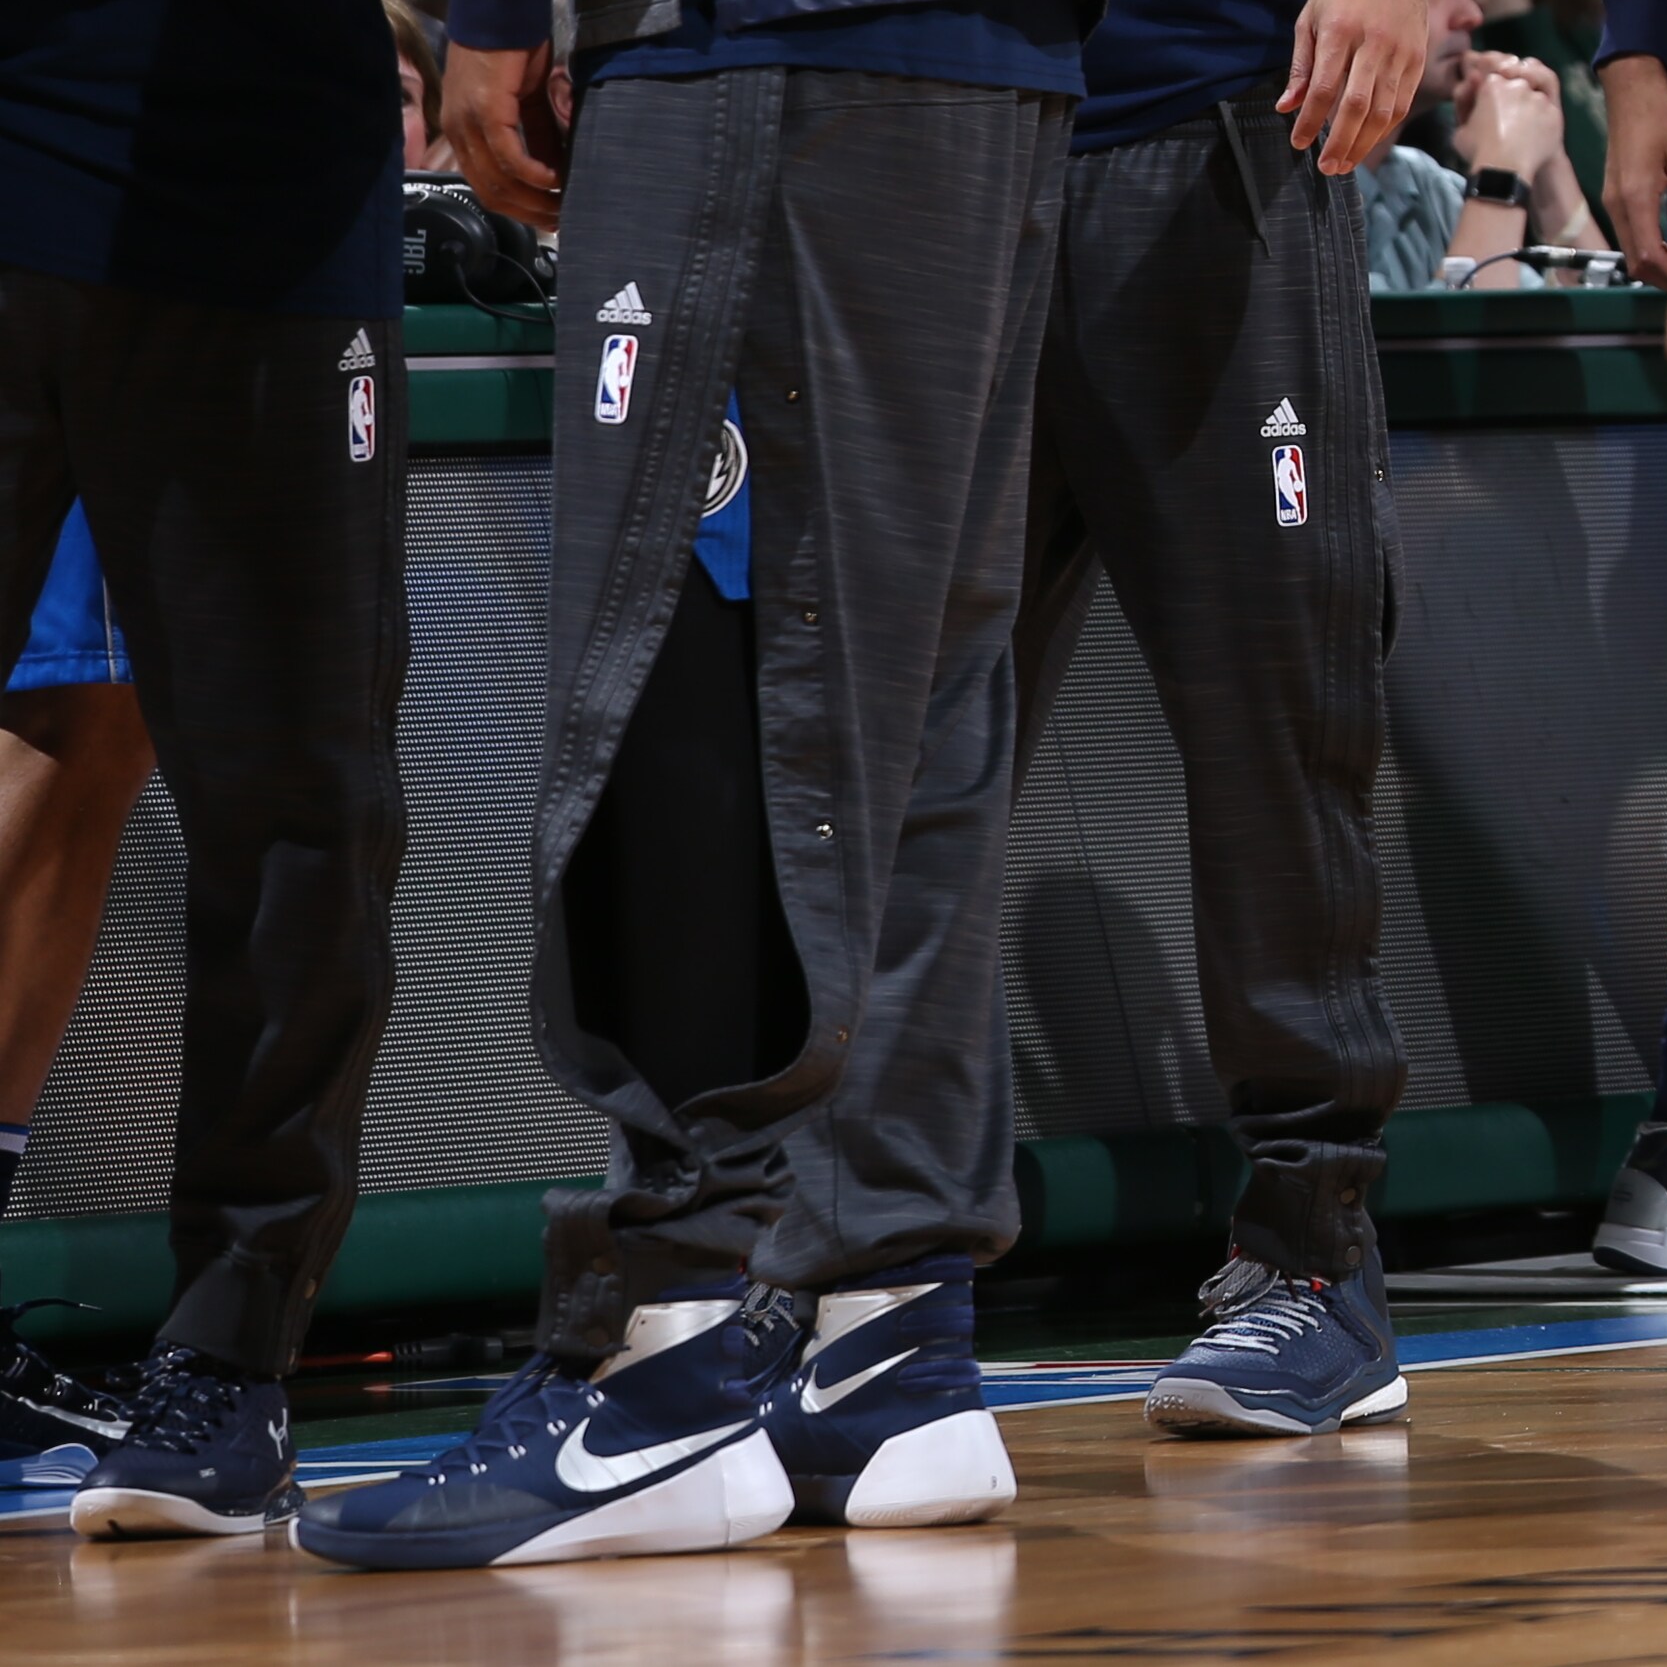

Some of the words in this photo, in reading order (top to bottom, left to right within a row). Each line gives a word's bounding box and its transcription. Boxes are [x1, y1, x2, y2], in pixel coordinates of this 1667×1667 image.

[597, 307, 652, 325] adidas
[1260, 421, 1307, 437] adidas
[1280, 508, 1298, 521] NBA
